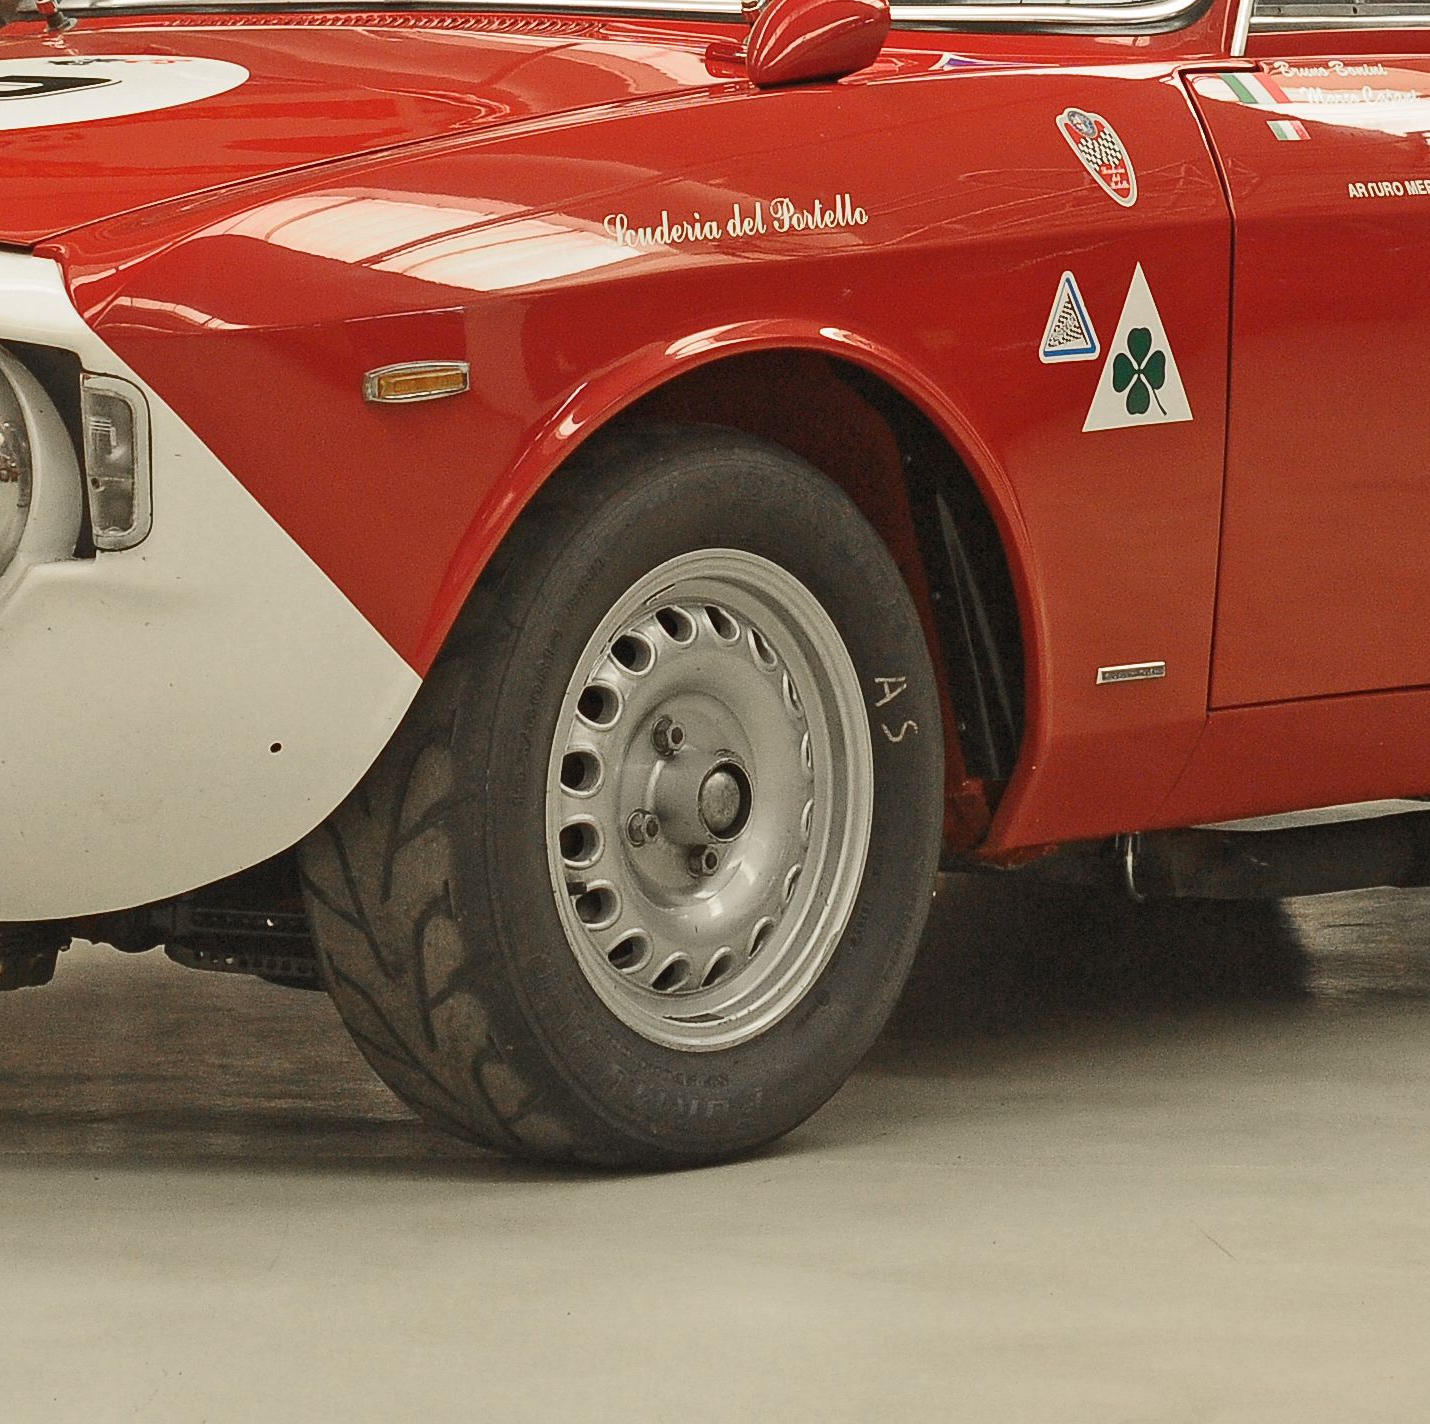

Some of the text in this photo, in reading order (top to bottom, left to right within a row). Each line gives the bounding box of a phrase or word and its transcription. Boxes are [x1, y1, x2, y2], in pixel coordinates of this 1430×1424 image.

[1274, 61, 1329, 78] Bruno
[1348, 181, 1405, 198] ARTURO
[603, 193, 869, 246] Scuderia del Portello
